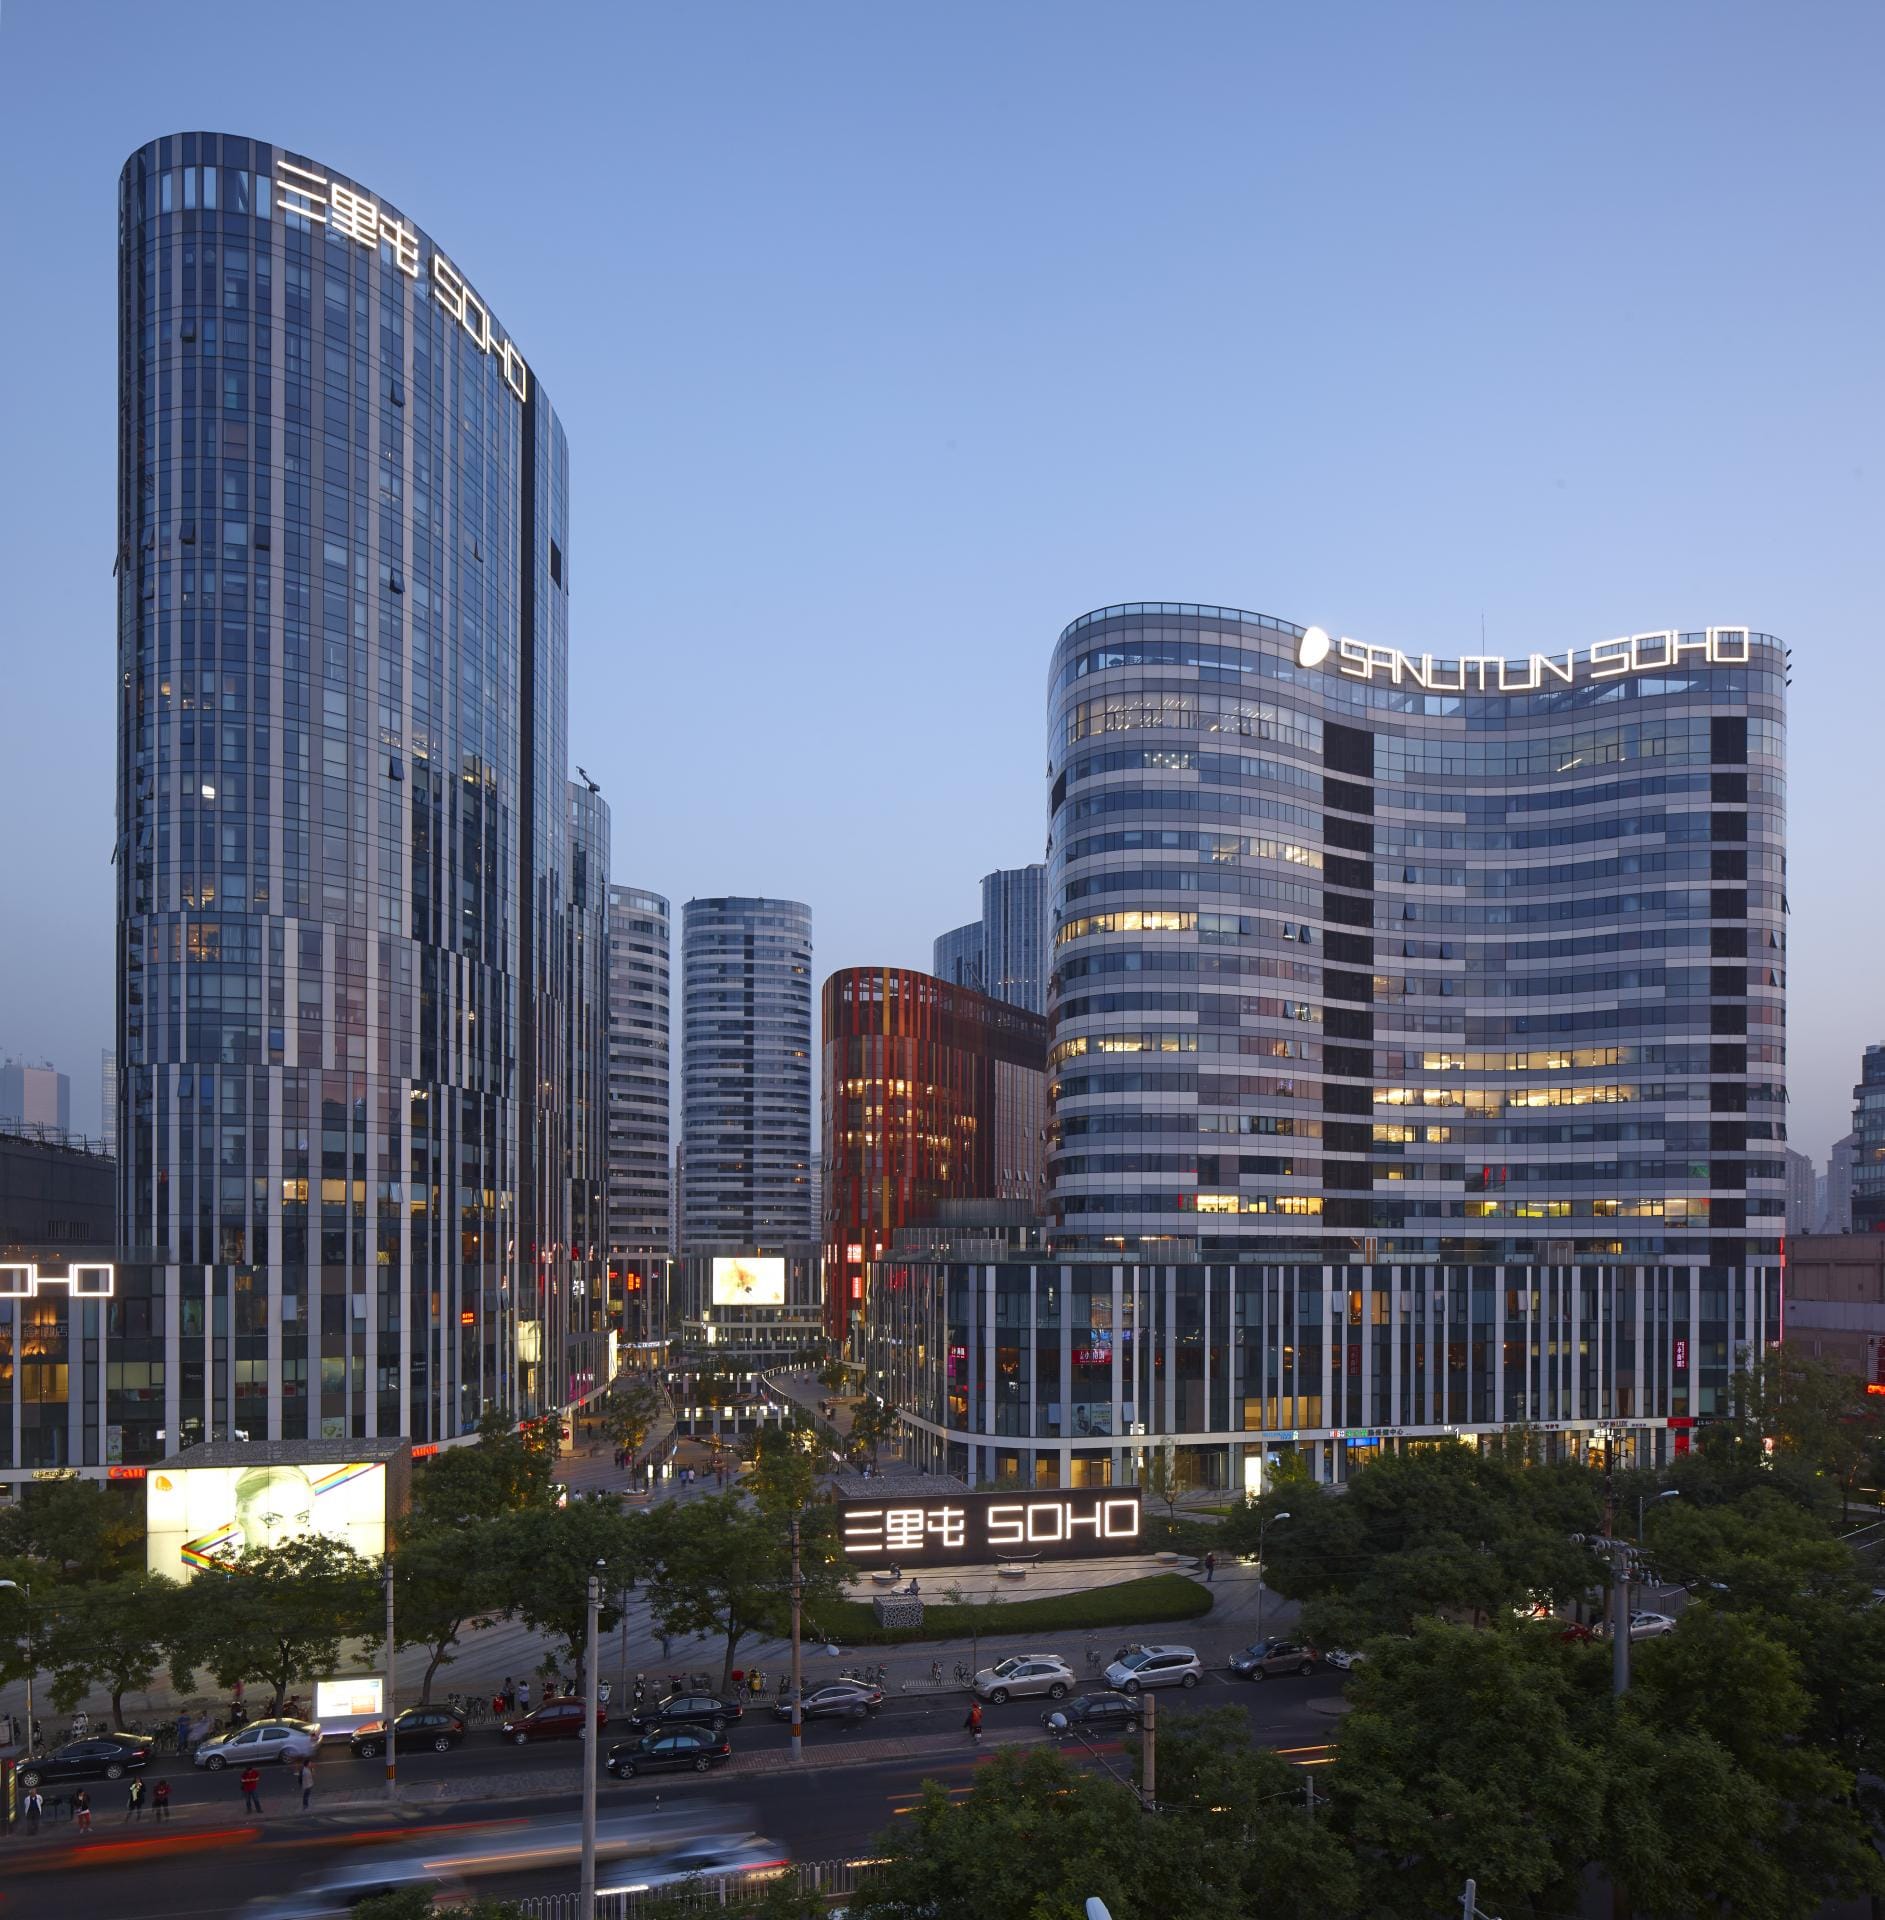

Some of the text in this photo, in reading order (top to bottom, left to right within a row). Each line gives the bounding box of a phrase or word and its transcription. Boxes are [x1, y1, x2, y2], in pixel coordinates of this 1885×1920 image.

[277, 160, 527, 403] 三里屯 SOHO
[1341, 626, 1749, 691] SANLITUN SOHO
[845, 1499, 1139, 1551] 三里屯 SOHO
